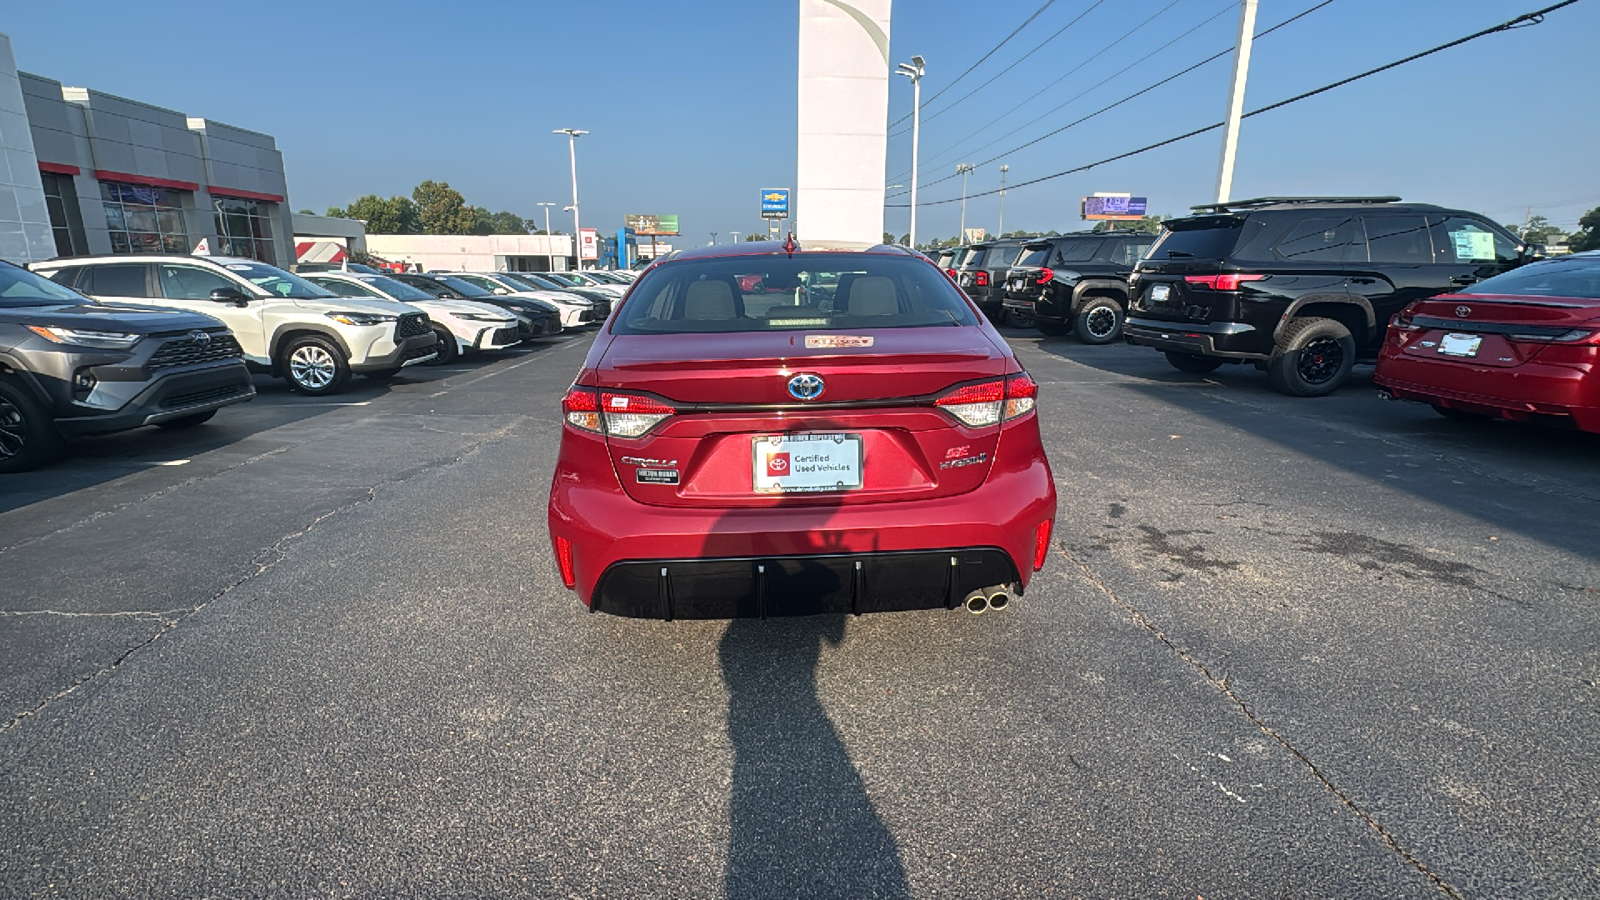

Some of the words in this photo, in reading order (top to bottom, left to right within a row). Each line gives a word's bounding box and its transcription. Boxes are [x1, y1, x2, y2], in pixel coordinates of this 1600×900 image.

[621, 456, 677, 467] COROLLA
[794, 454, 830, 463] Certified
[940, 456, 983, 470] HYBRID
[795, 464, 816, 473] Used
[816, 462, 851, 472] Vehicles
